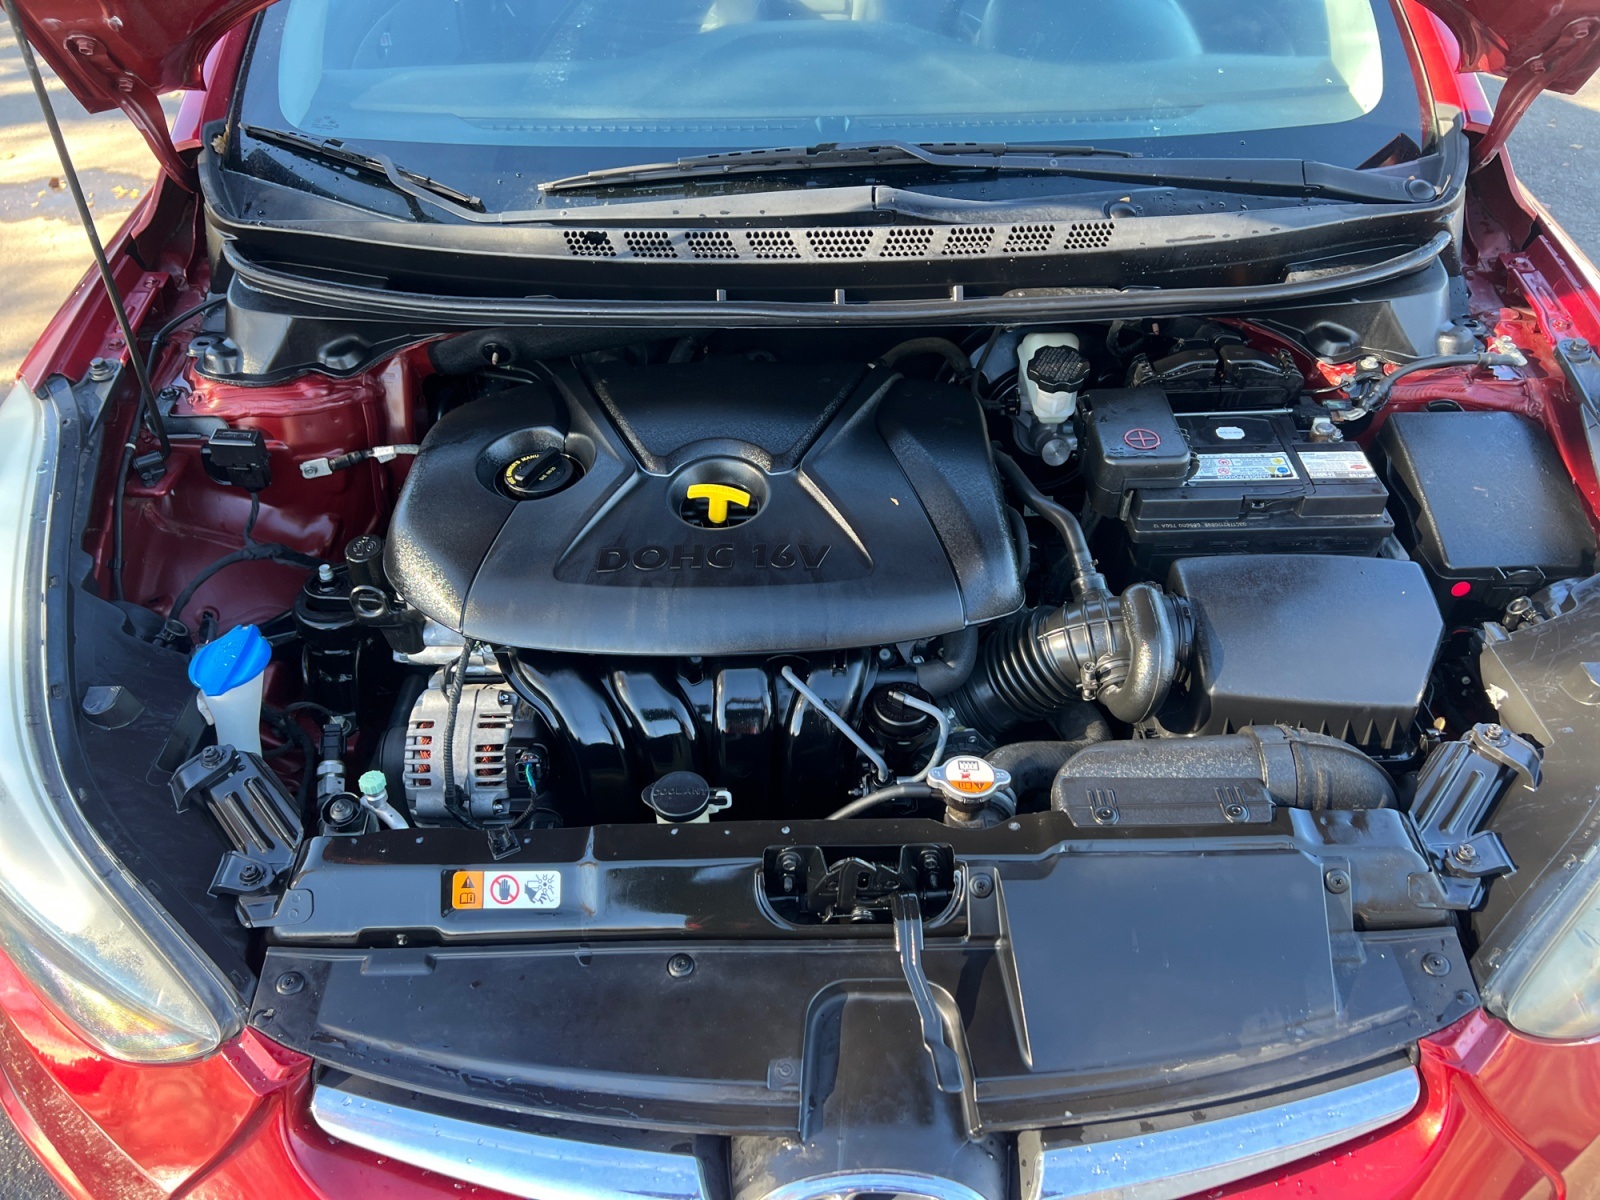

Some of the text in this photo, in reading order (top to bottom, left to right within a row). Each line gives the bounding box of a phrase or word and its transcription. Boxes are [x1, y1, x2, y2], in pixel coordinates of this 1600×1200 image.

[596, 543, 832, 573] DOHC 16V
[653, 788, 707, 796] COOLANT
